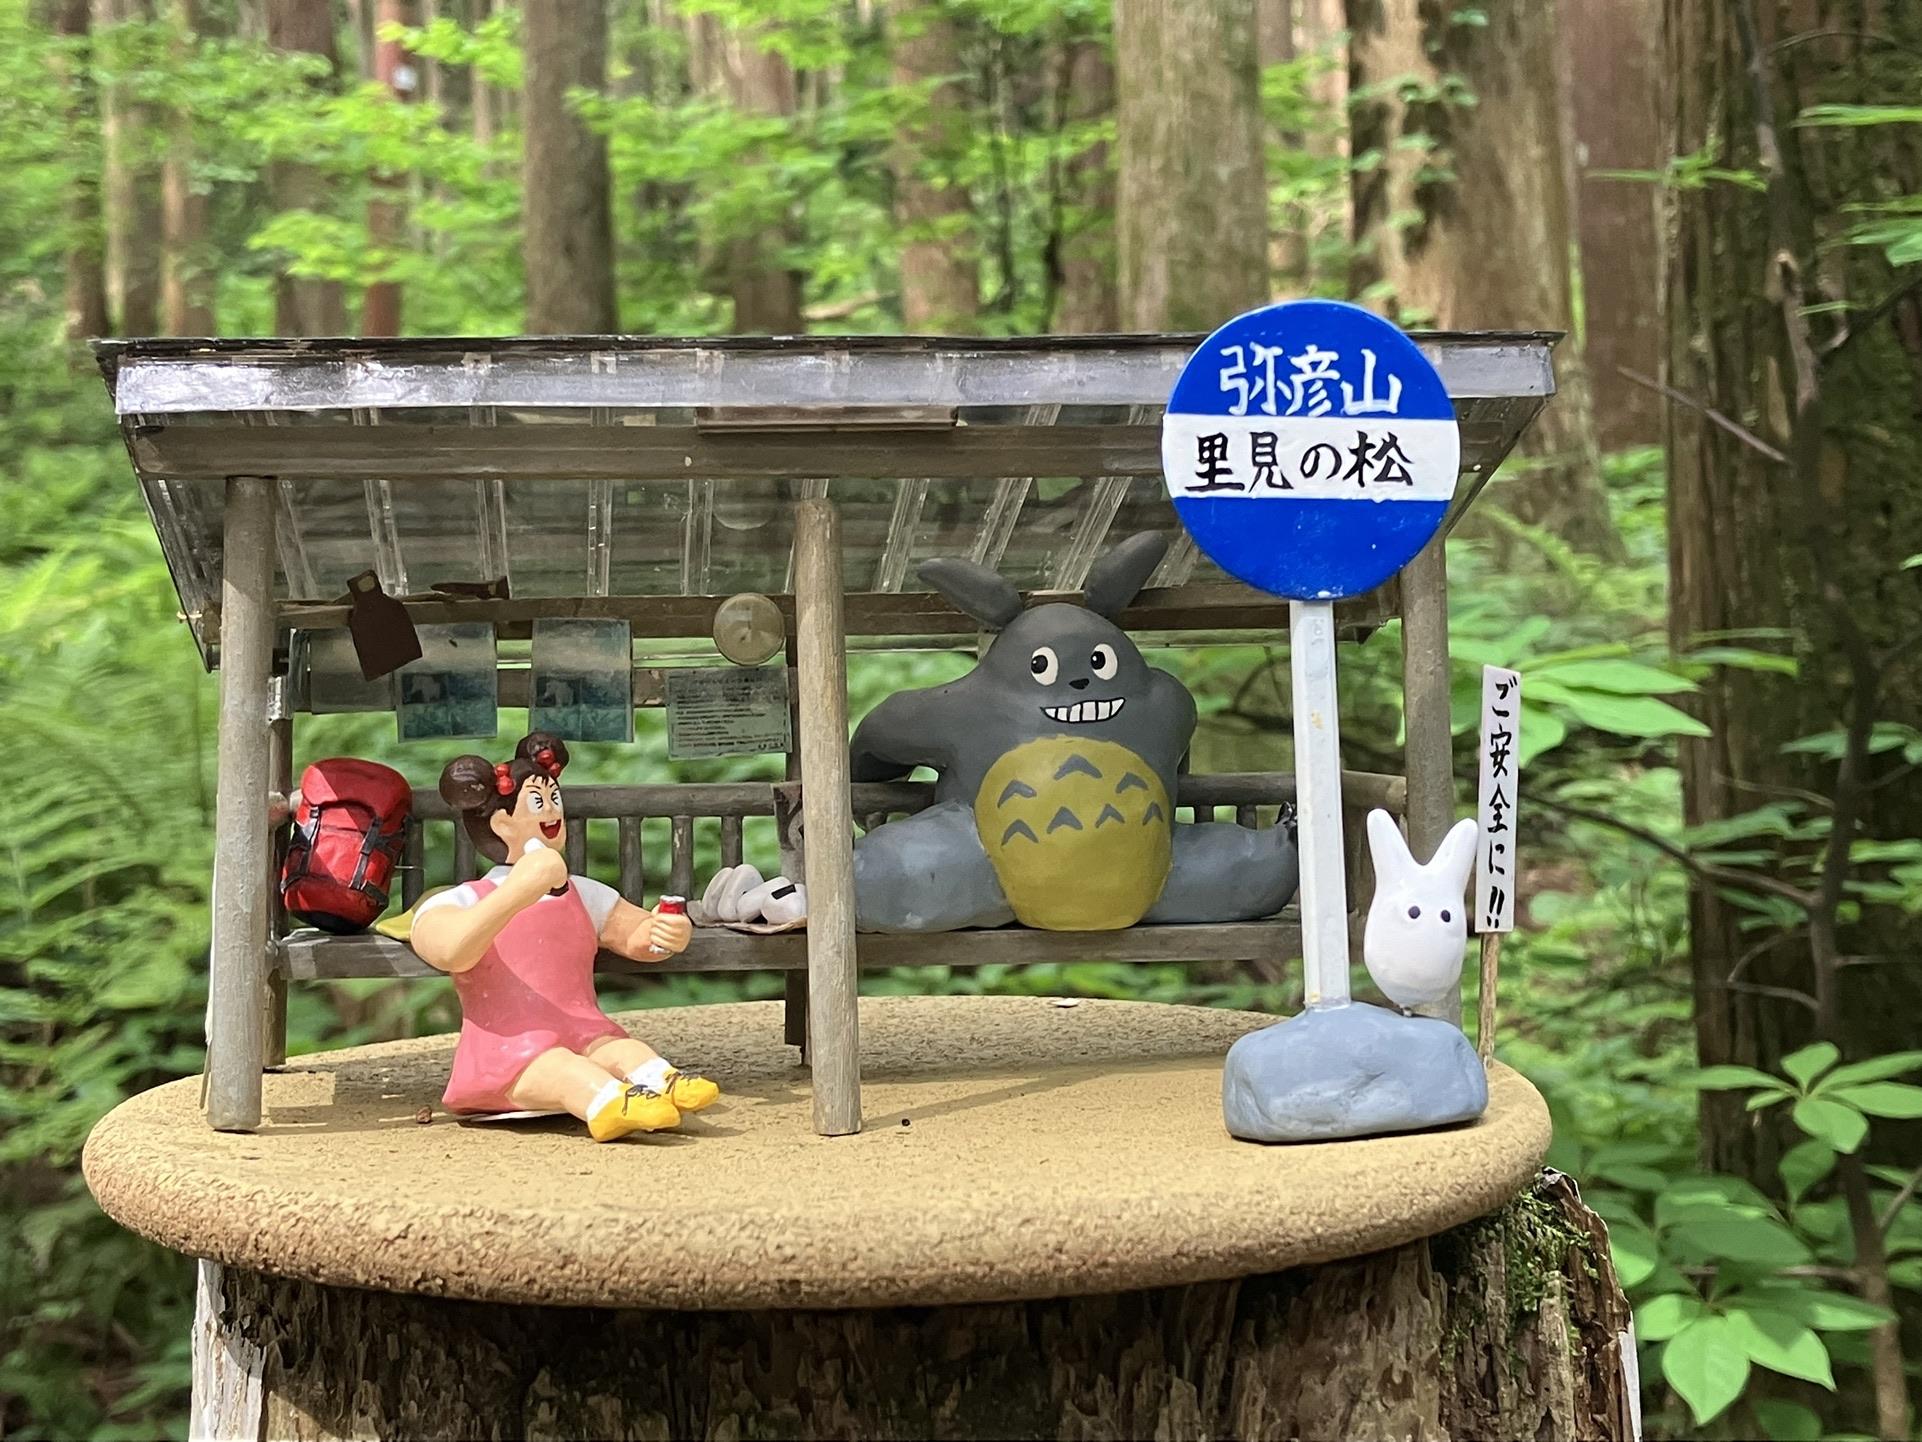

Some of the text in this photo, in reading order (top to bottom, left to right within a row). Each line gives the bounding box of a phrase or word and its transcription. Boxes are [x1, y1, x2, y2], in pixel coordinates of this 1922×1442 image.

[1220, 341, 1402, 416] 弥彦山
[1184, 430, 1414, 492] 里見の松
